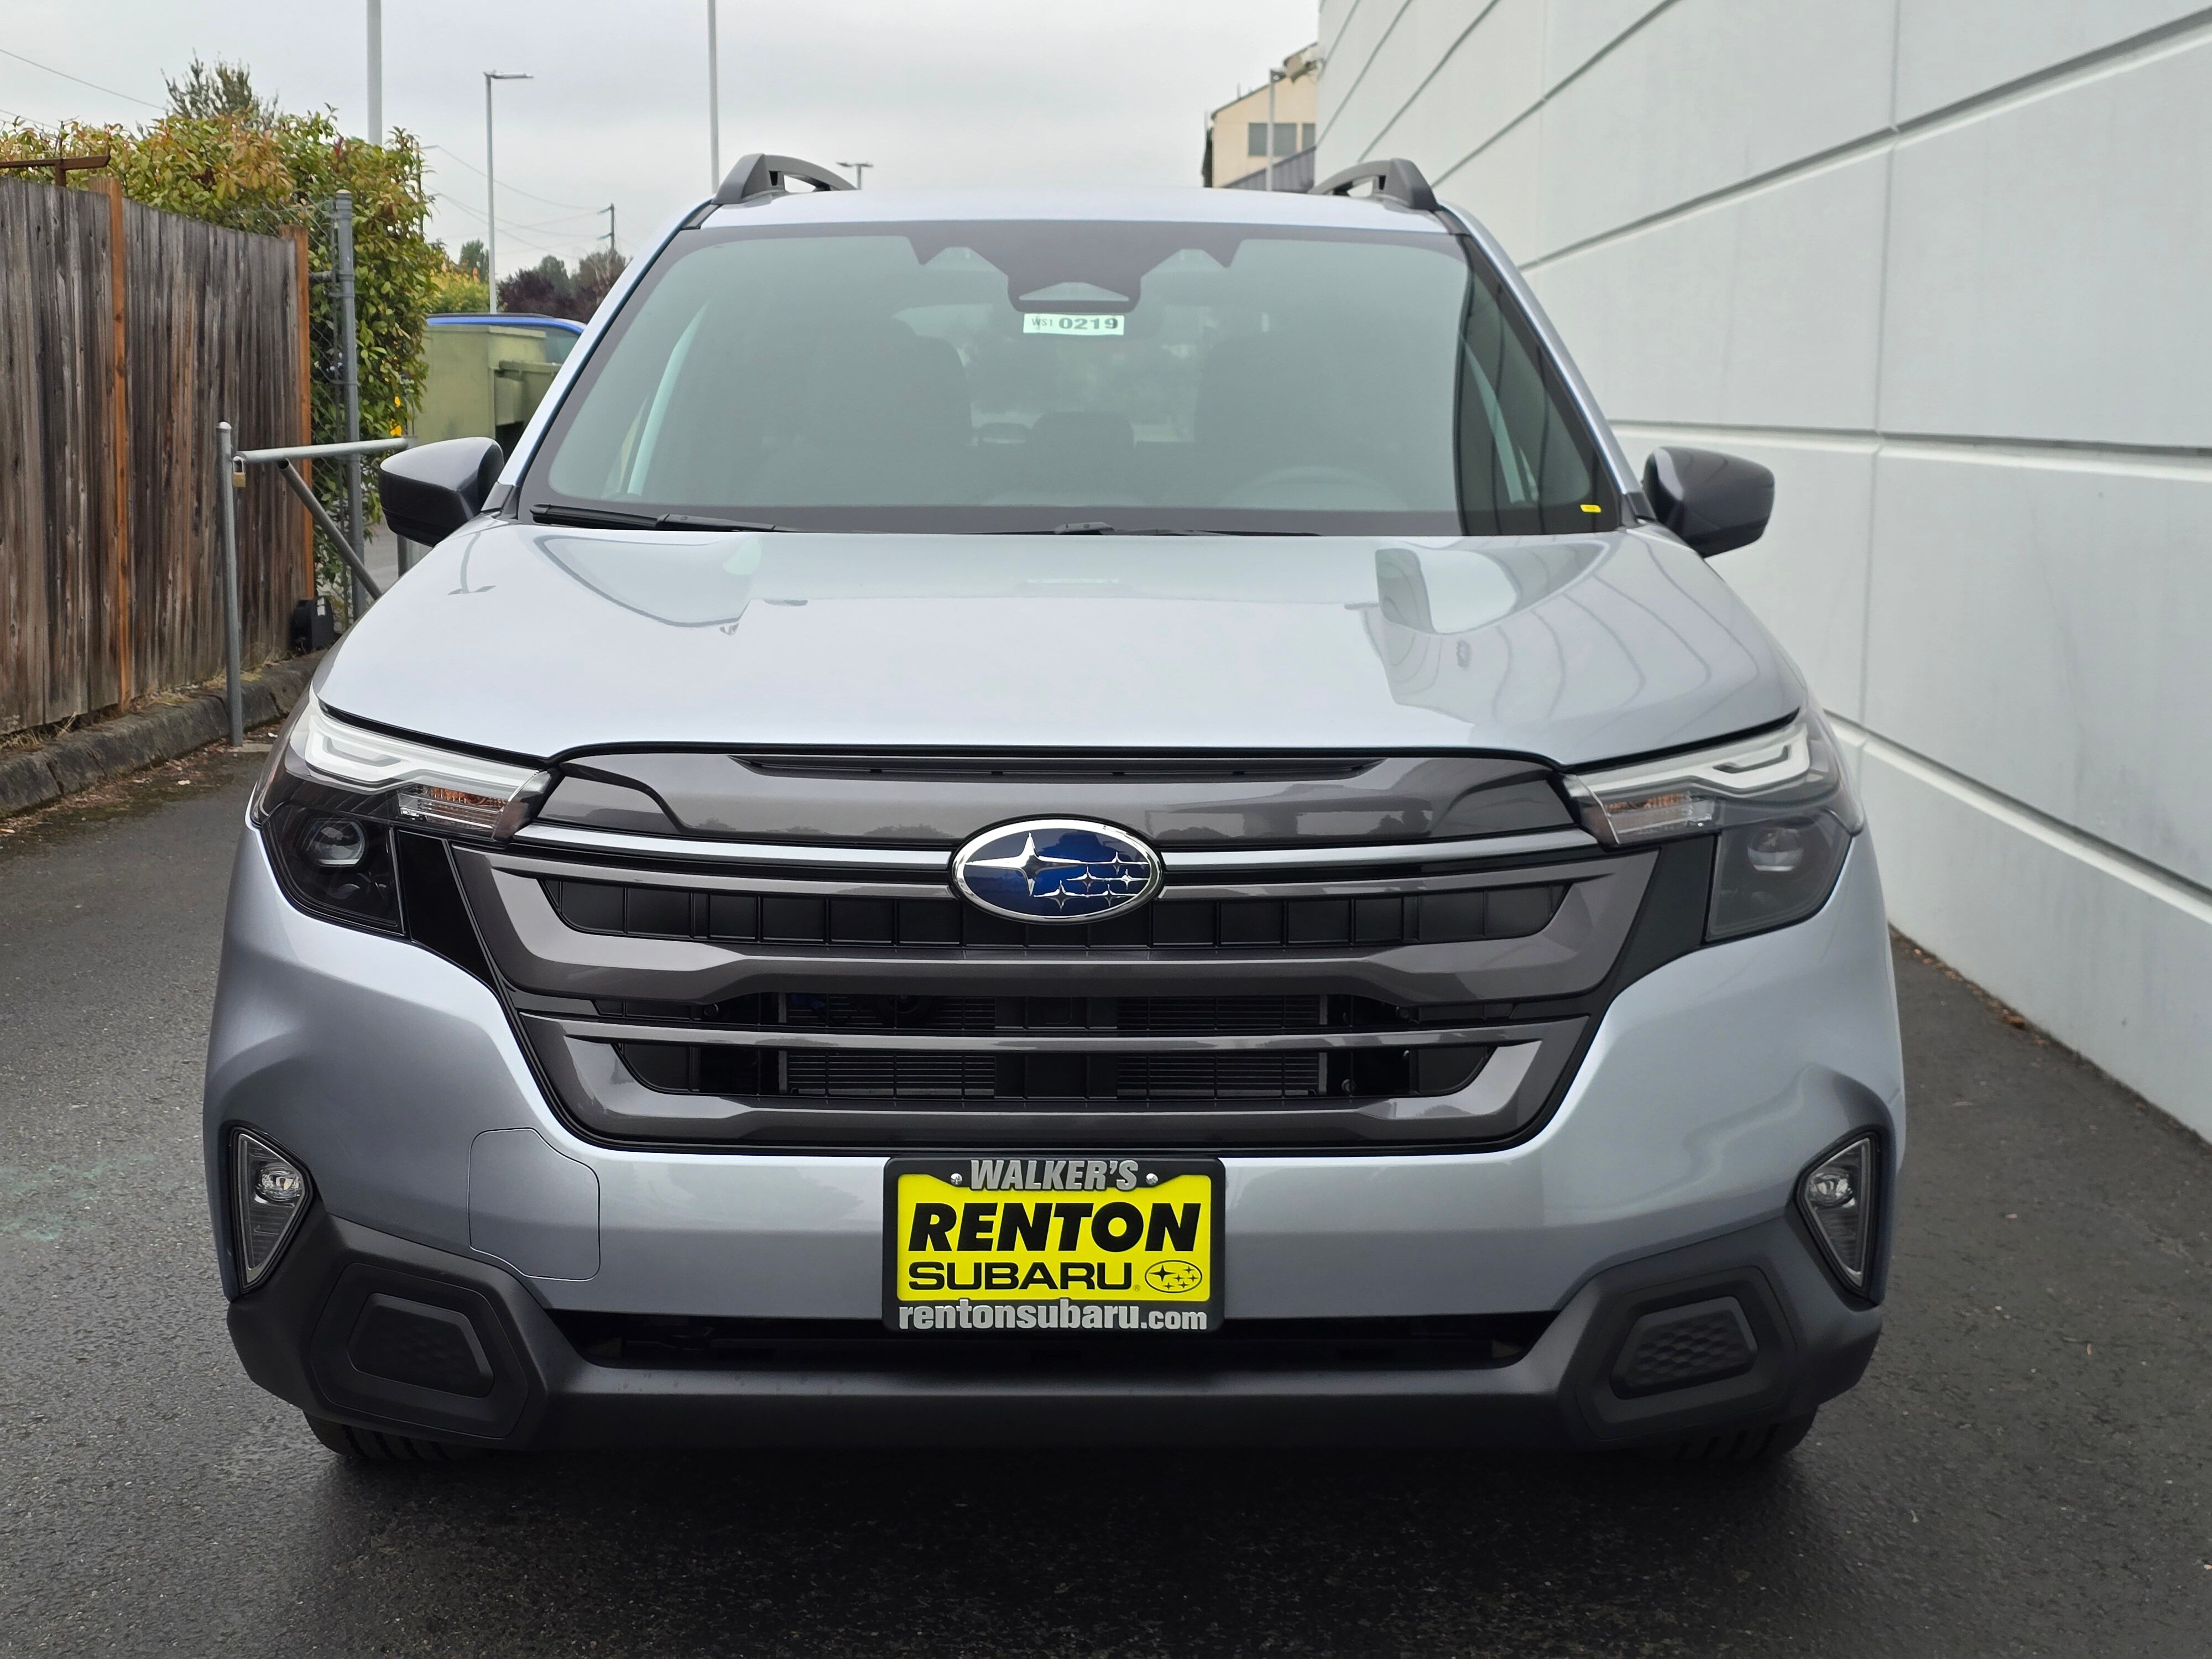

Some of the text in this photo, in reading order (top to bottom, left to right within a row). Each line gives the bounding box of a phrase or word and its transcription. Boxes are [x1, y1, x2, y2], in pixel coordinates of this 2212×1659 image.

[1058, 317, 1118, 330] 0219
[970, 1159, 1139, 1191] WALKER'S
[908, 1201, 1202, 1253] RENTON
[908, 1262, 1132, 1290] SUBARU
[899, 1298, 1208, 1330] rentonsubaru.com
